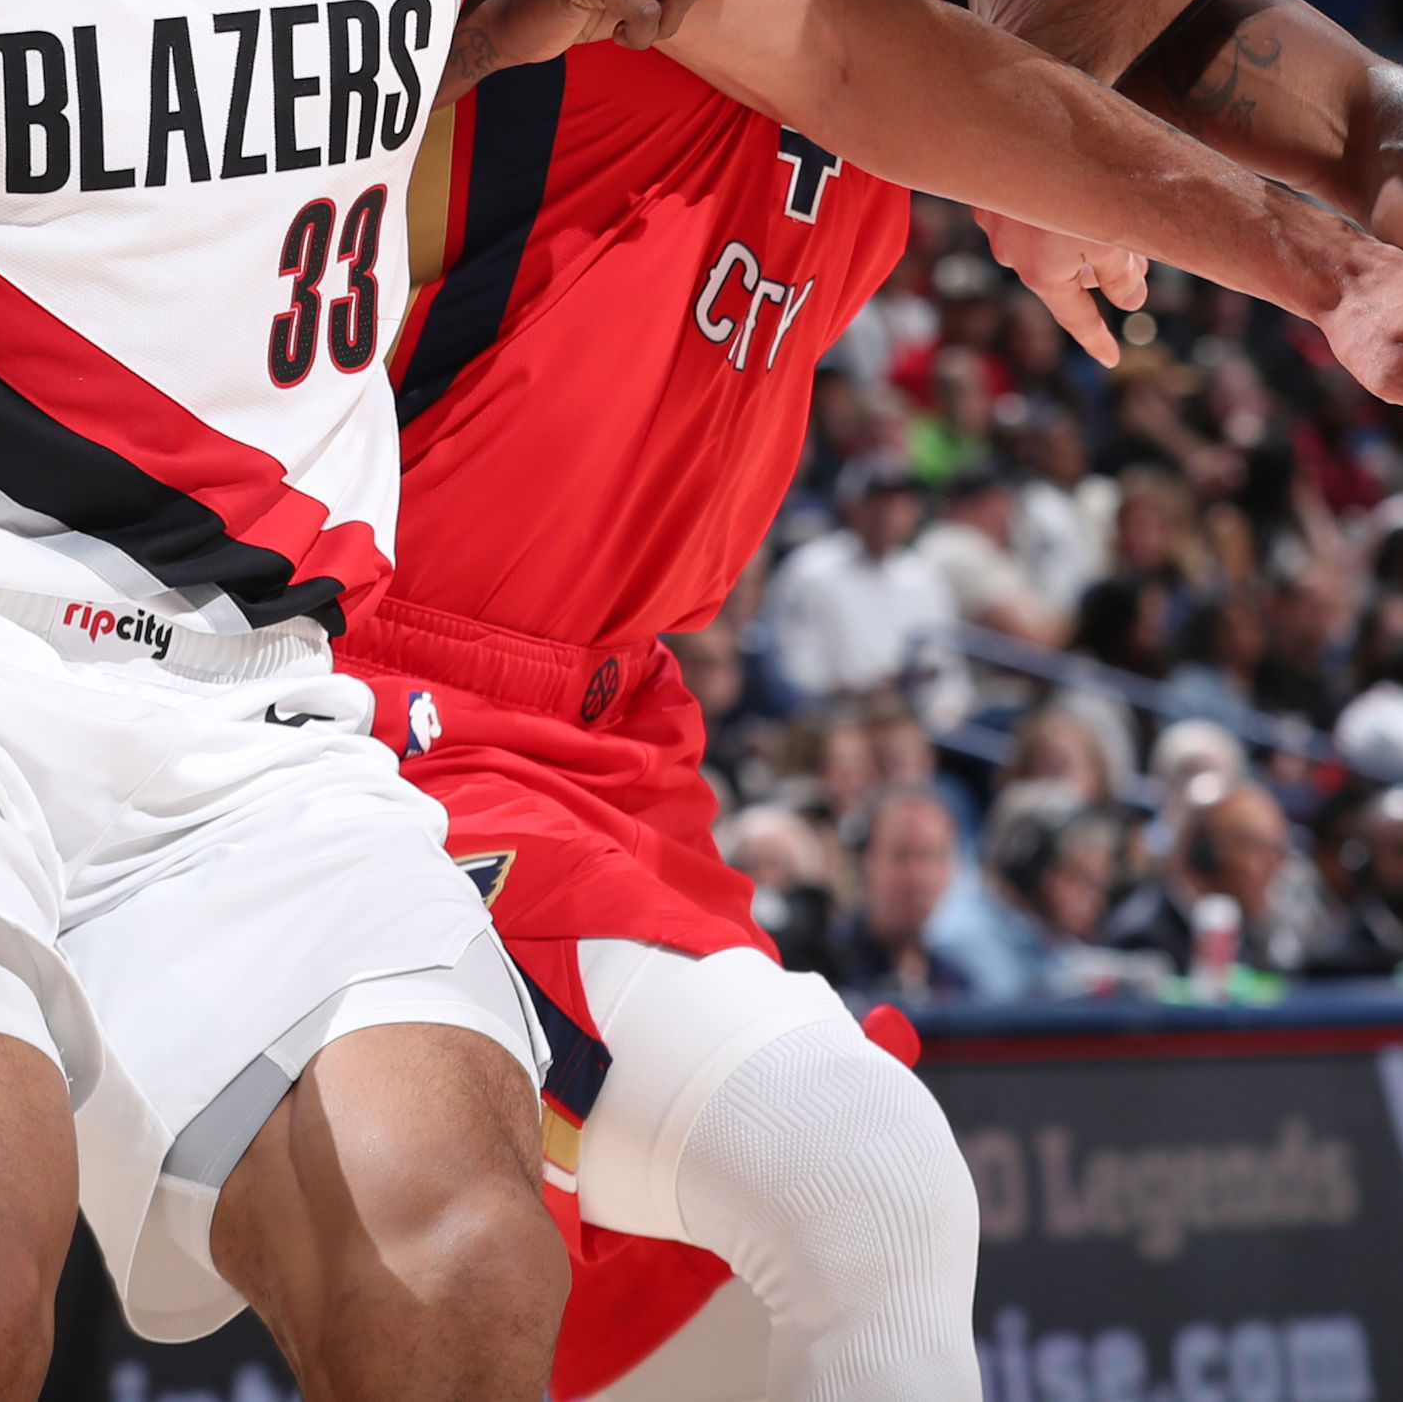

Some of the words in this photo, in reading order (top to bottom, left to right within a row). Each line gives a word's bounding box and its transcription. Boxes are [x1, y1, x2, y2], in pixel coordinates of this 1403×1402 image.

[268, 183, 388, 389] 33
[695, 240, 815, 372] CTY
[63, 601, 173, 661] ripcity
